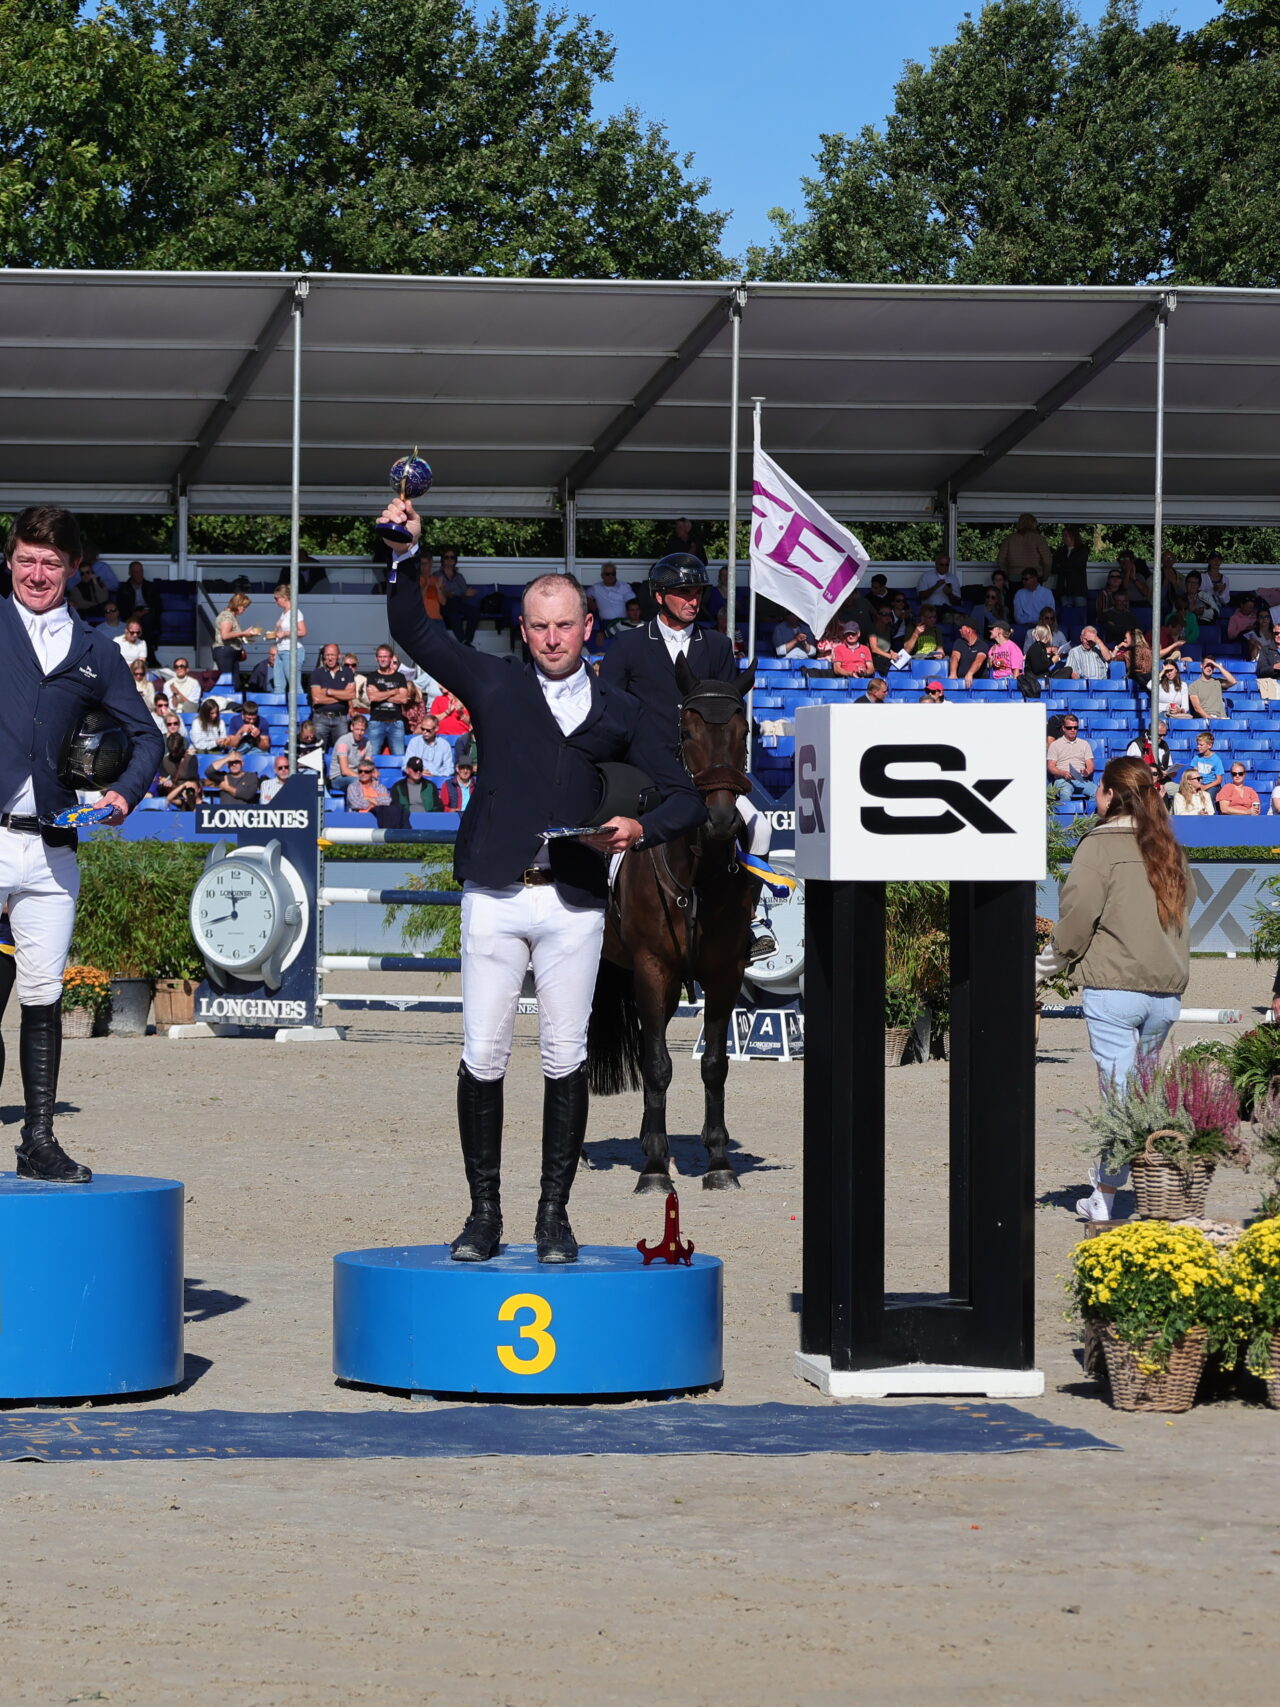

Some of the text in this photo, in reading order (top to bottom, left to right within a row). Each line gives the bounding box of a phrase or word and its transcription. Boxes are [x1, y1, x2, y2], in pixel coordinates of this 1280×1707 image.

[201, 809, 309, 829] LONGINES
[206, 890, 215, 899] 10
[260, 890, 267, 899] 2
[201, 909, 208, 918] 9
[264, 910, 272, 919] 3
[205, 929, 213, 938] 8
[258, 930, 267, 939] 4
[217, 944, 224, 953] 7
[249, 944, 256, 953] 5
[232, 949, 240, 959] 6
[785, 954, 794, 964] 5
[766, 960, 775, 970] 6
[200, 998, 306, 1019] LONGINES
[760, 1016, 773, 1035] A
[789, 1016, 797, 1035] A
[496, 1293, 556, 1375] 3
